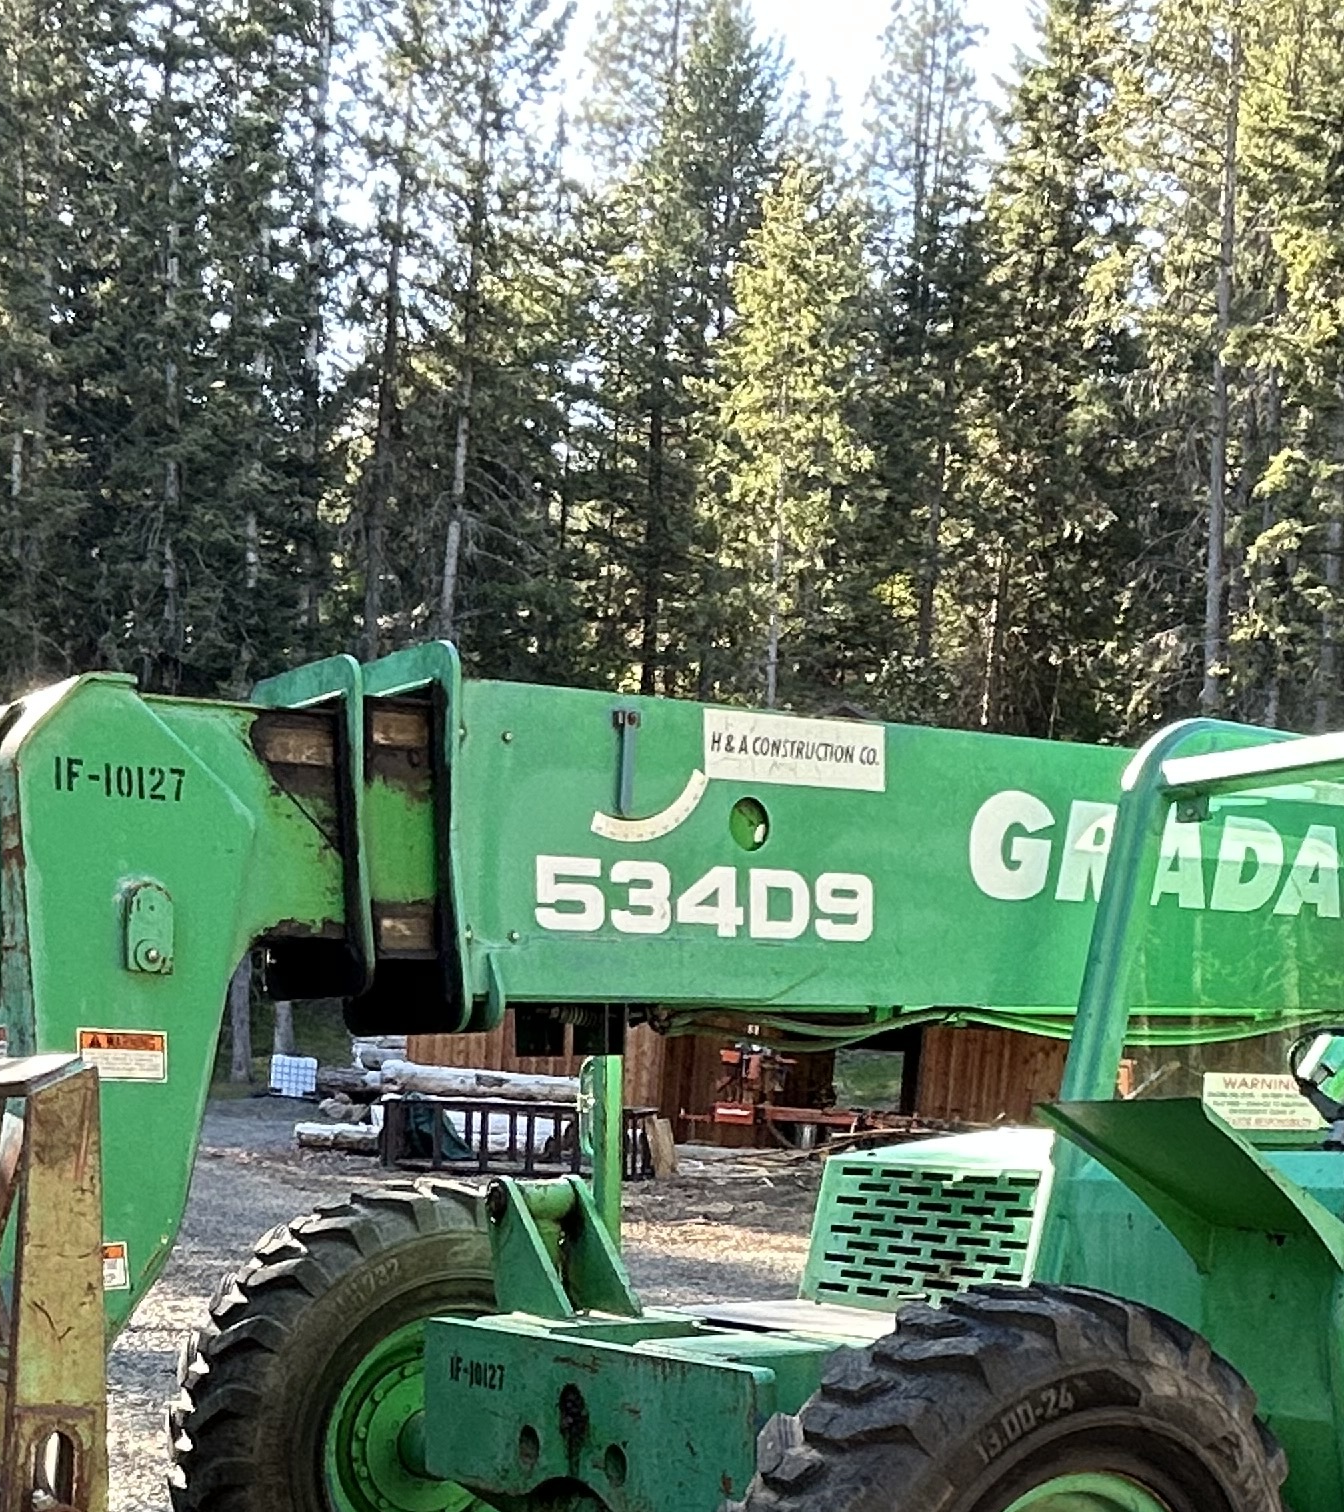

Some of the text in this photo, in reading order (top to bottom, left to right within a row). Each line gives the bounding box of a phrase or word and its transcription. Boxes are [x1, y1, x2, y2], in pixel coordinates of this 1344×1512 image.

[710, 731, 880, 766] H & A CONSTRUCTION CO.
[535, 855, 874, 942] 534D9
